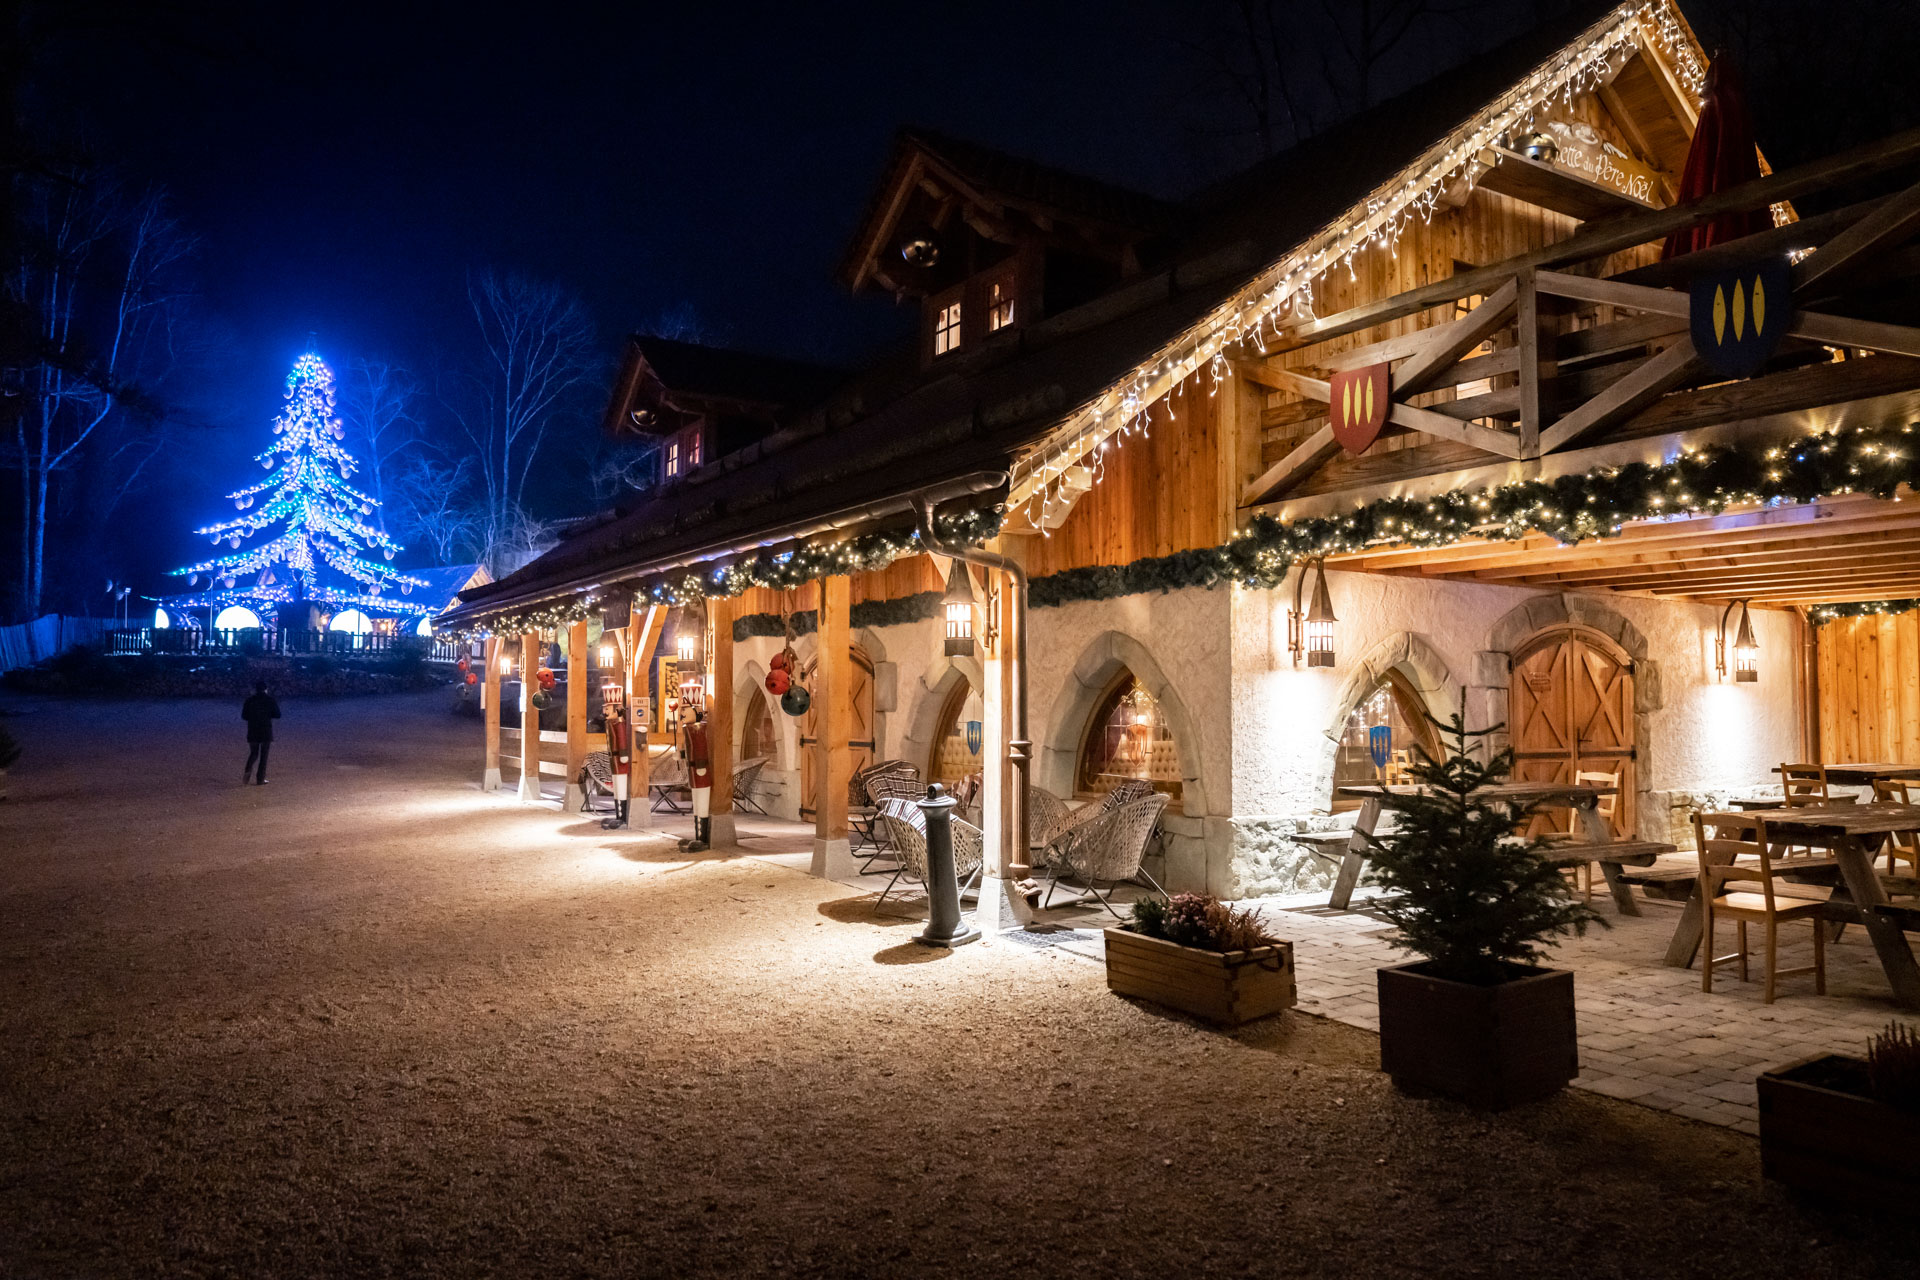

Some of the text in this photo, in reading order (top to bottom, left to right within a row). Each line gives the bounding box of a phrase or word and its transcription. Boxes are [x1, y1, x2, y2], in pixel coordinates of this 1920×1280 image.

[1583, 156, 1594, 173] du
[1592, 154, 1625, 187] Père
[1621, 173, 1654, 203] Noël
